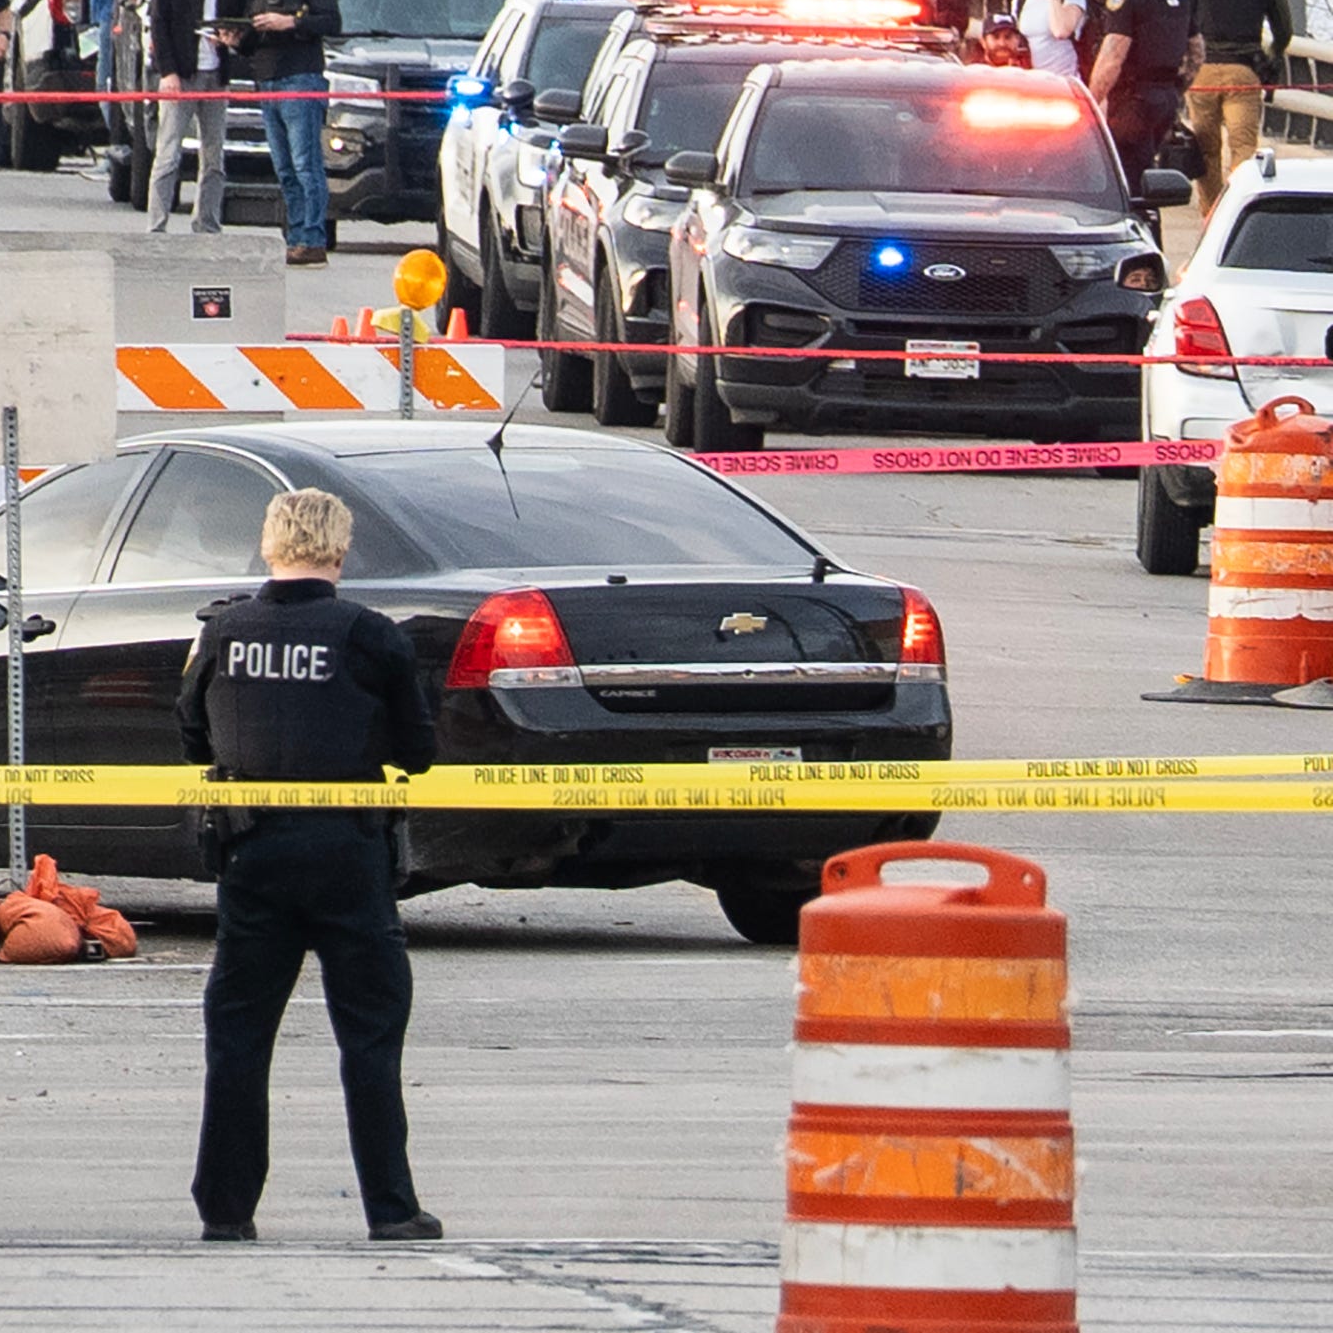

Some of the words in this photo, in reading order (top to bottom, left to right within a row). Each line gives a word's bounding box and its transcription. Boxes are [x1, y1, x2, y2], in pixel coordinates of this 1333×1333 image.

[873, 452, 932, 468] CROSS
[939, 450, 971, 466] NOT
[975, 450, 1001, 465] DO
[1007, 448, 1063, 464] SCENE
[1067, 446, 1121, 463] CRIME
[1155, 443, 1216, 460] CROSS
[724, 455, 781, 473] SCENE
[786, 453, 838, 471] CRIME
[228, 641, 329, 681] POLICE
[600, 689, 656, 698] CAPRICE
[749, 764, 791, 782] POLICE
[797, 764, 822, 781] LINE
[829, 764, 845, 781] DO
[849, 763, 872, 781] NOT
[878, 763, 919, 780] CROSS
[1027, 761, 1069, 778] POLICE
[1075, 760, 1100, 777] LINE
[1106, 760, 1123, 776] DO
[1127, 760, 1149, 776] NOT
[1156, 759, 1197, 775] CROSS
[1303, 757, 1333, 773] POLI
[5, 769, 21, 782] DO
[25, 769, 47, 783] NOT
[53, 769, 94, 783] CROSS
[475, 767, 515, 784] POLICE
[521, 767, 545, 784] LINE
[553, 767, 569, 784] DO
[573, 767, 596, 784] NOT
[602, 767, 643, 784] CROSS
